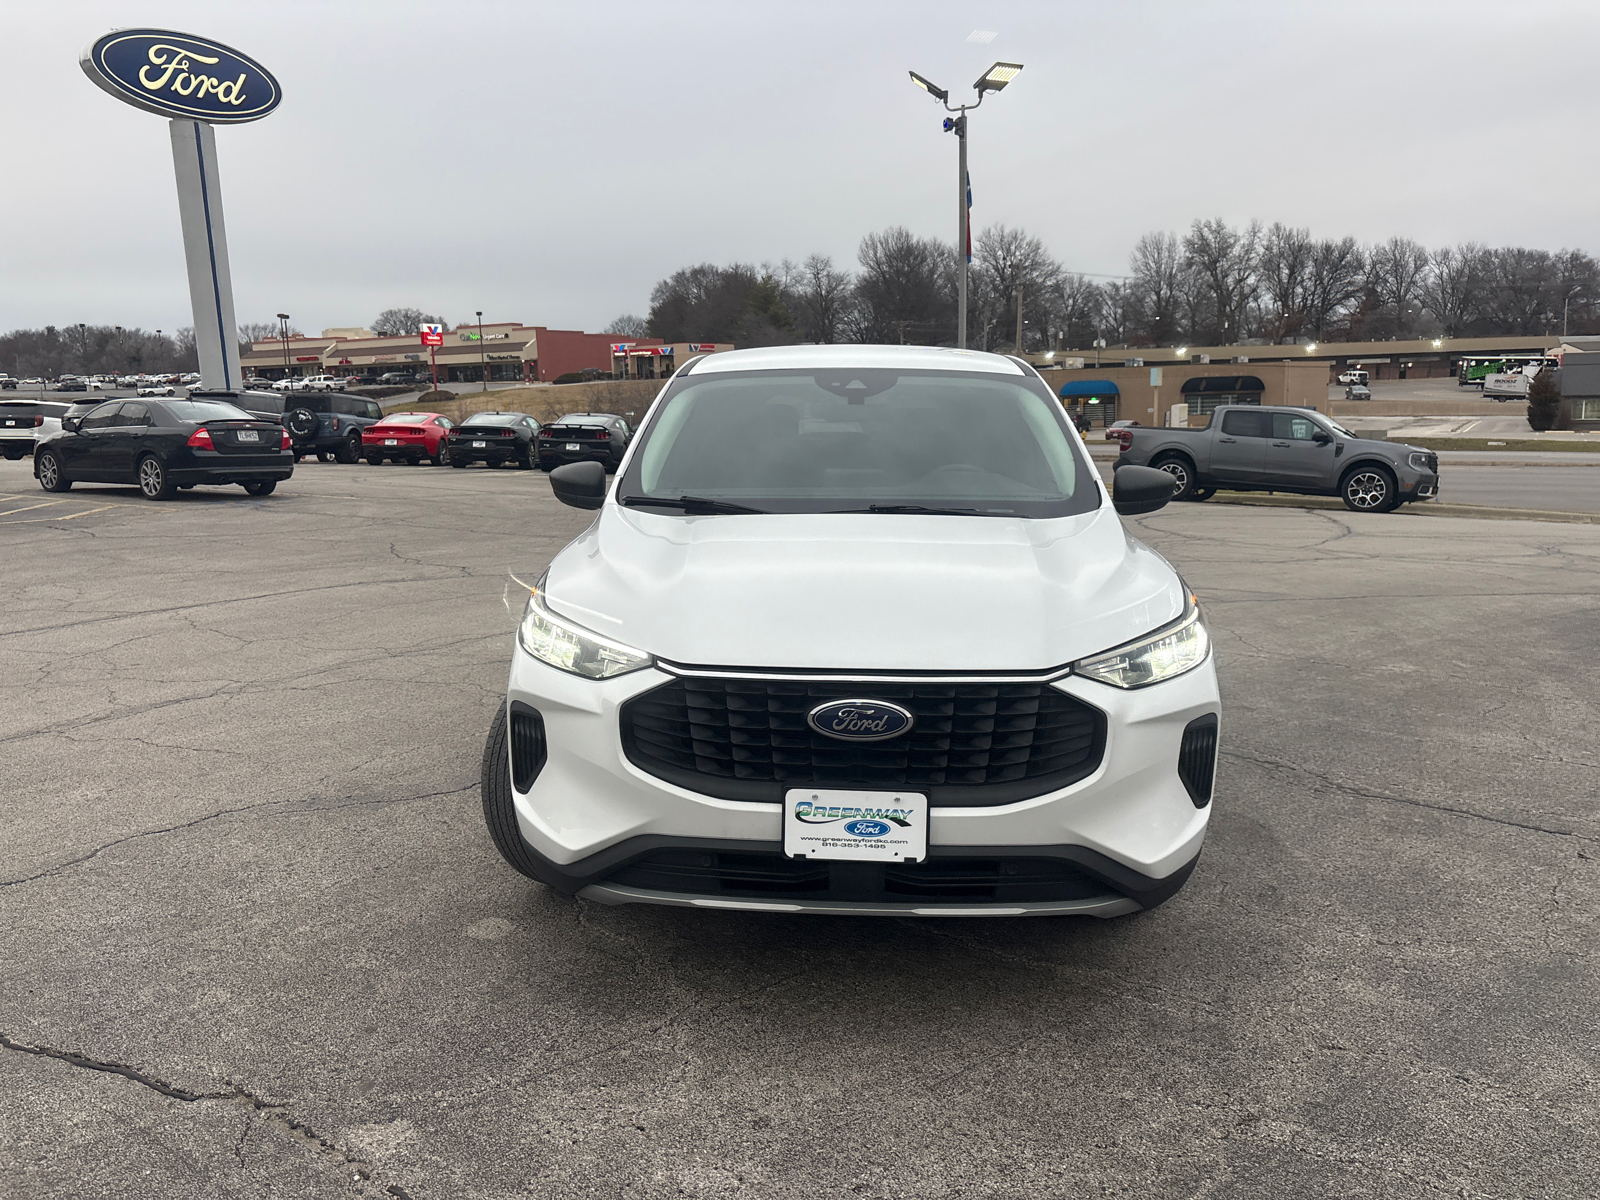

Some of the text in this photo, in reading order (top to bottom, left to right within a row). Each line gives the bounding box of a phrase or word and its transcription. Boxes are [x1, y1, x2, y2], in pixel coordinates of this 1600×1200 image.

[138, 44, 247, 106] Ford
[832, 707, 889, 732] Ford
[795, 801, 914, 820] GREENWAY
[854, 822, 881, 835] Ford
[800, 836, 908, 845] www.greenwayfordkc.com
